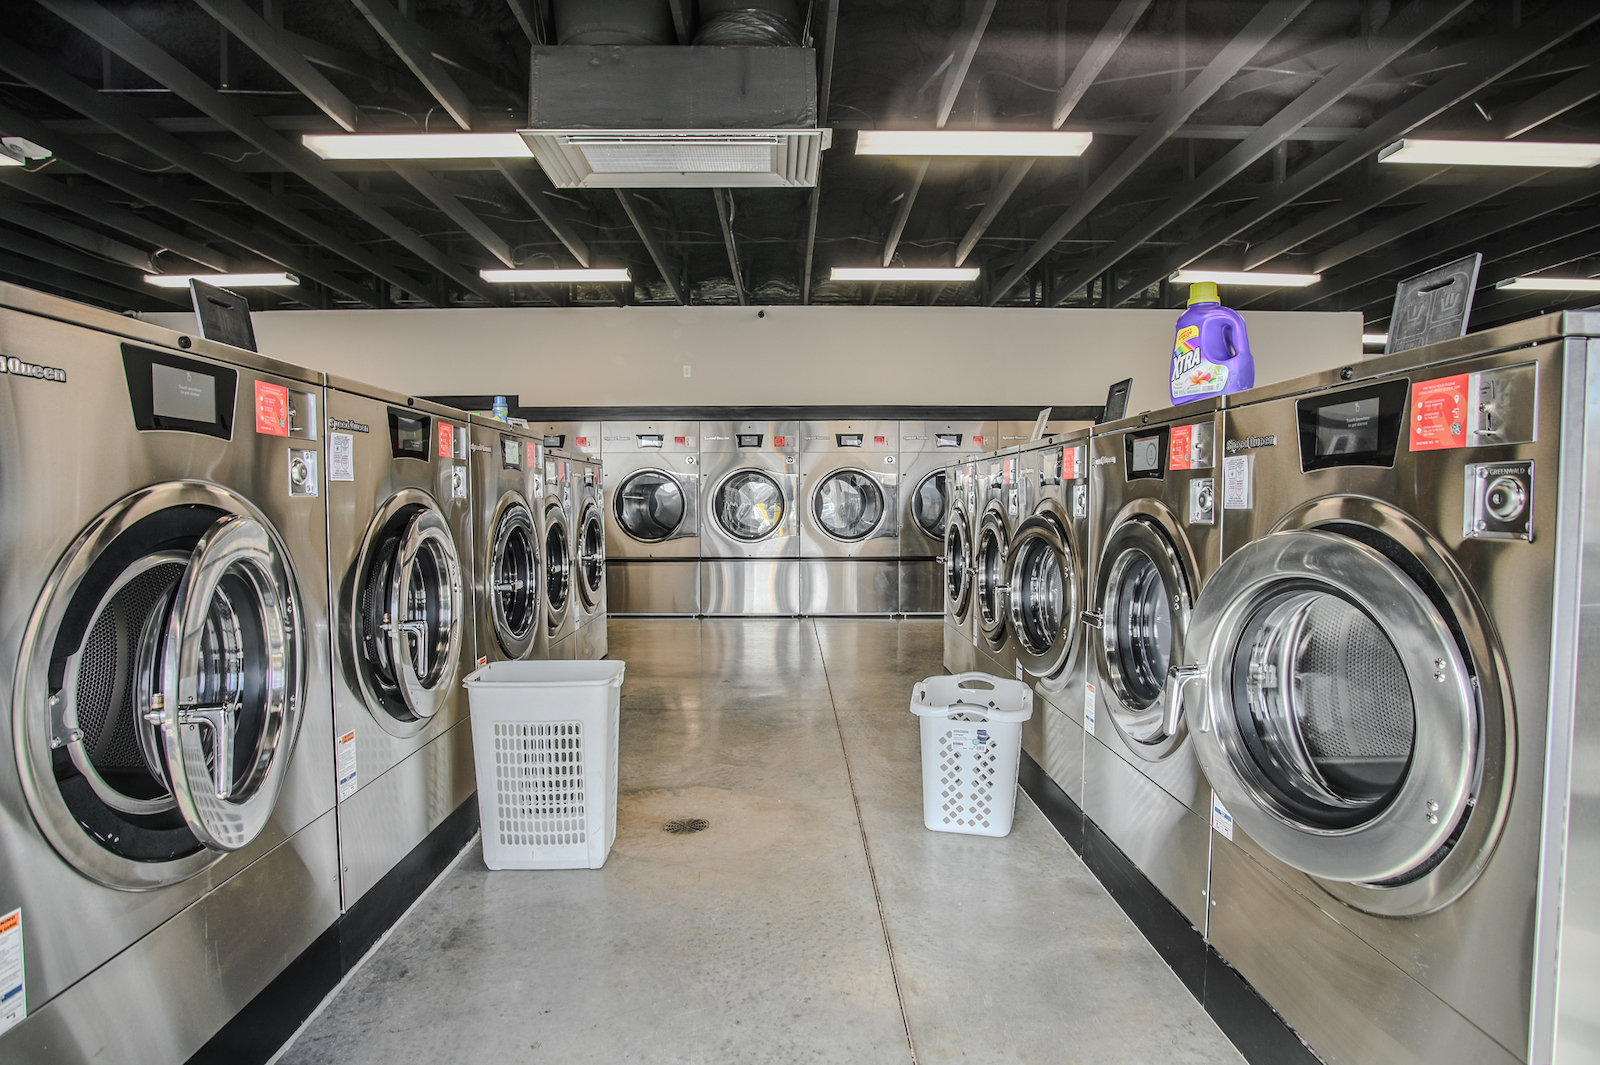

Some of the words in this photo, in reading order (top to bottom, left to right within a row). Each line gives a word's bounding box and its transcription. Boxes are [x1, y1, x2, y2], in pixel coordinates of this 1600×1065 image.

[7, 356, 66, 382] Queen
[1171, 346, 1201, 382] XTRA
[1490, 467, 1525, 475] GREENWALD
